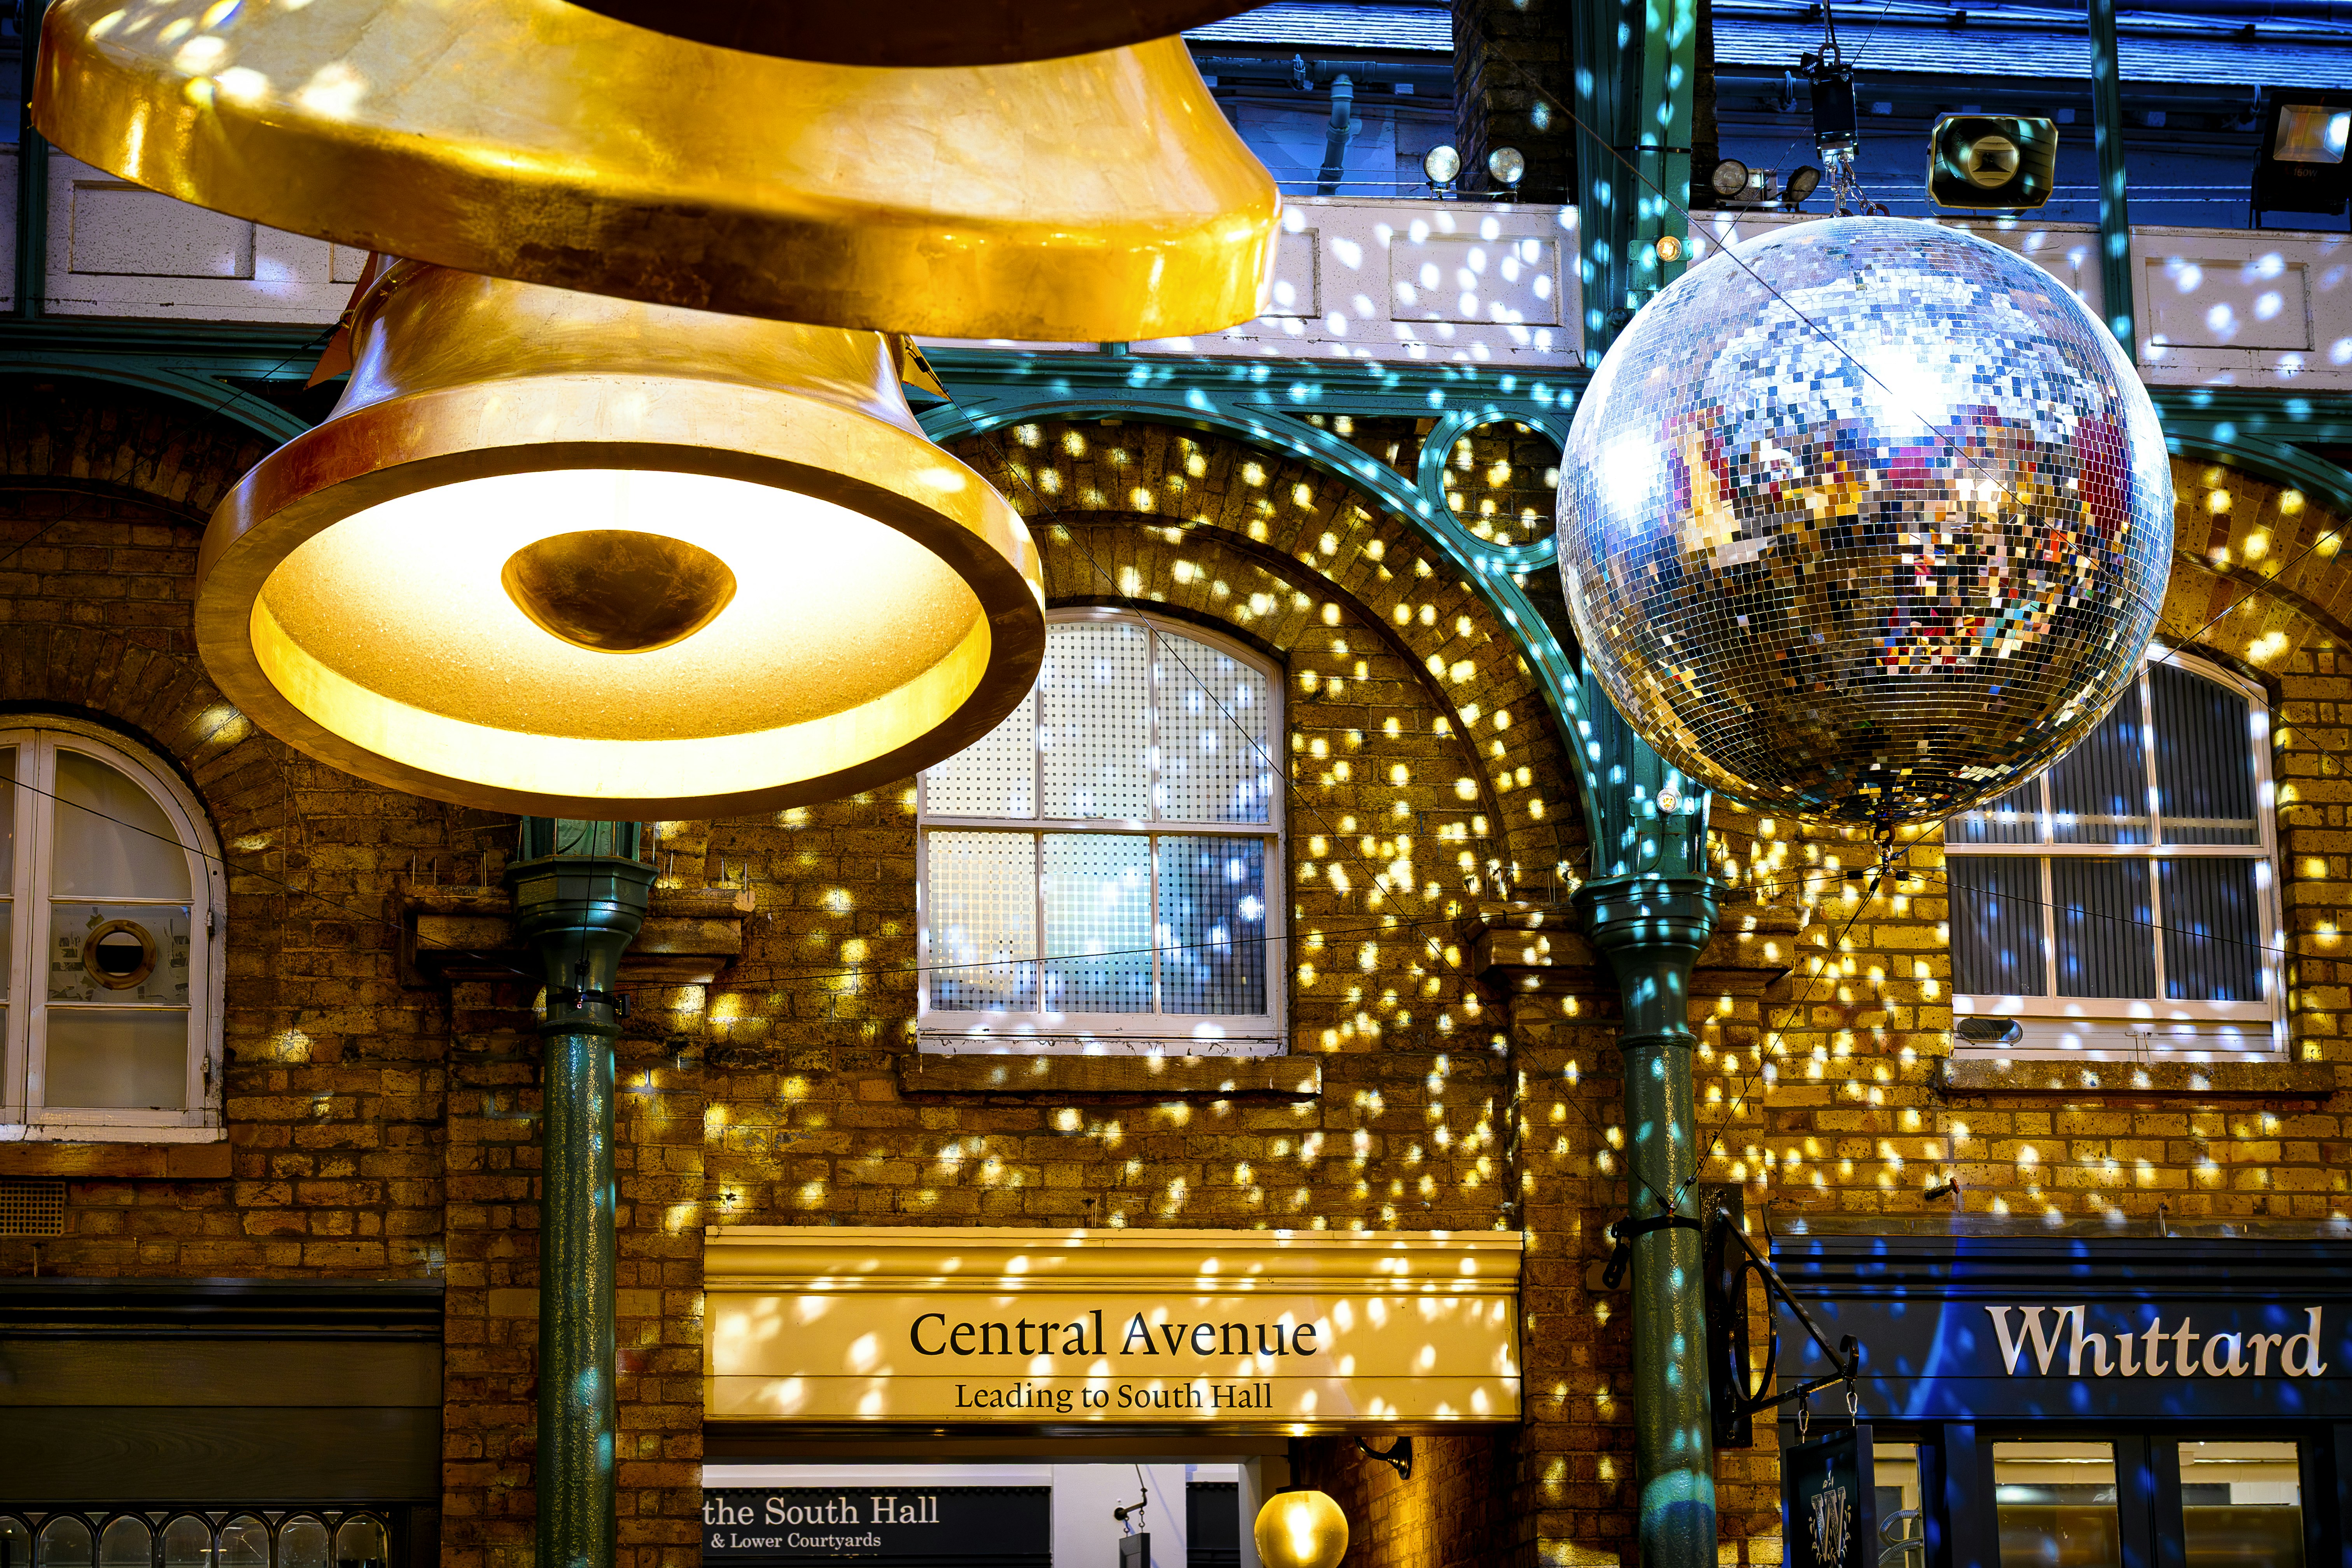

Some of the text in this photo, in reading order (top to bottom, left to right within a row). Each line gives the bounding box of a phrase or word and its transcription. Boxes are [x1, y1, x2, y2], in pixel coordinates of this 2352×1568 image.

[2293, 168, 2318, 177] 150W
[911, 1309, 1317, 1356] Central Avenue
[1984, 1305, 2328, 1377] Whittard
[955, 1382, 1273, 1413] Leading to South Hall
[702, 1496, 940, 1525] the South Hall
[1811, 1486, 1846, 1562] W
[711, 1532, 881, 1550] & Lower Courtyards
